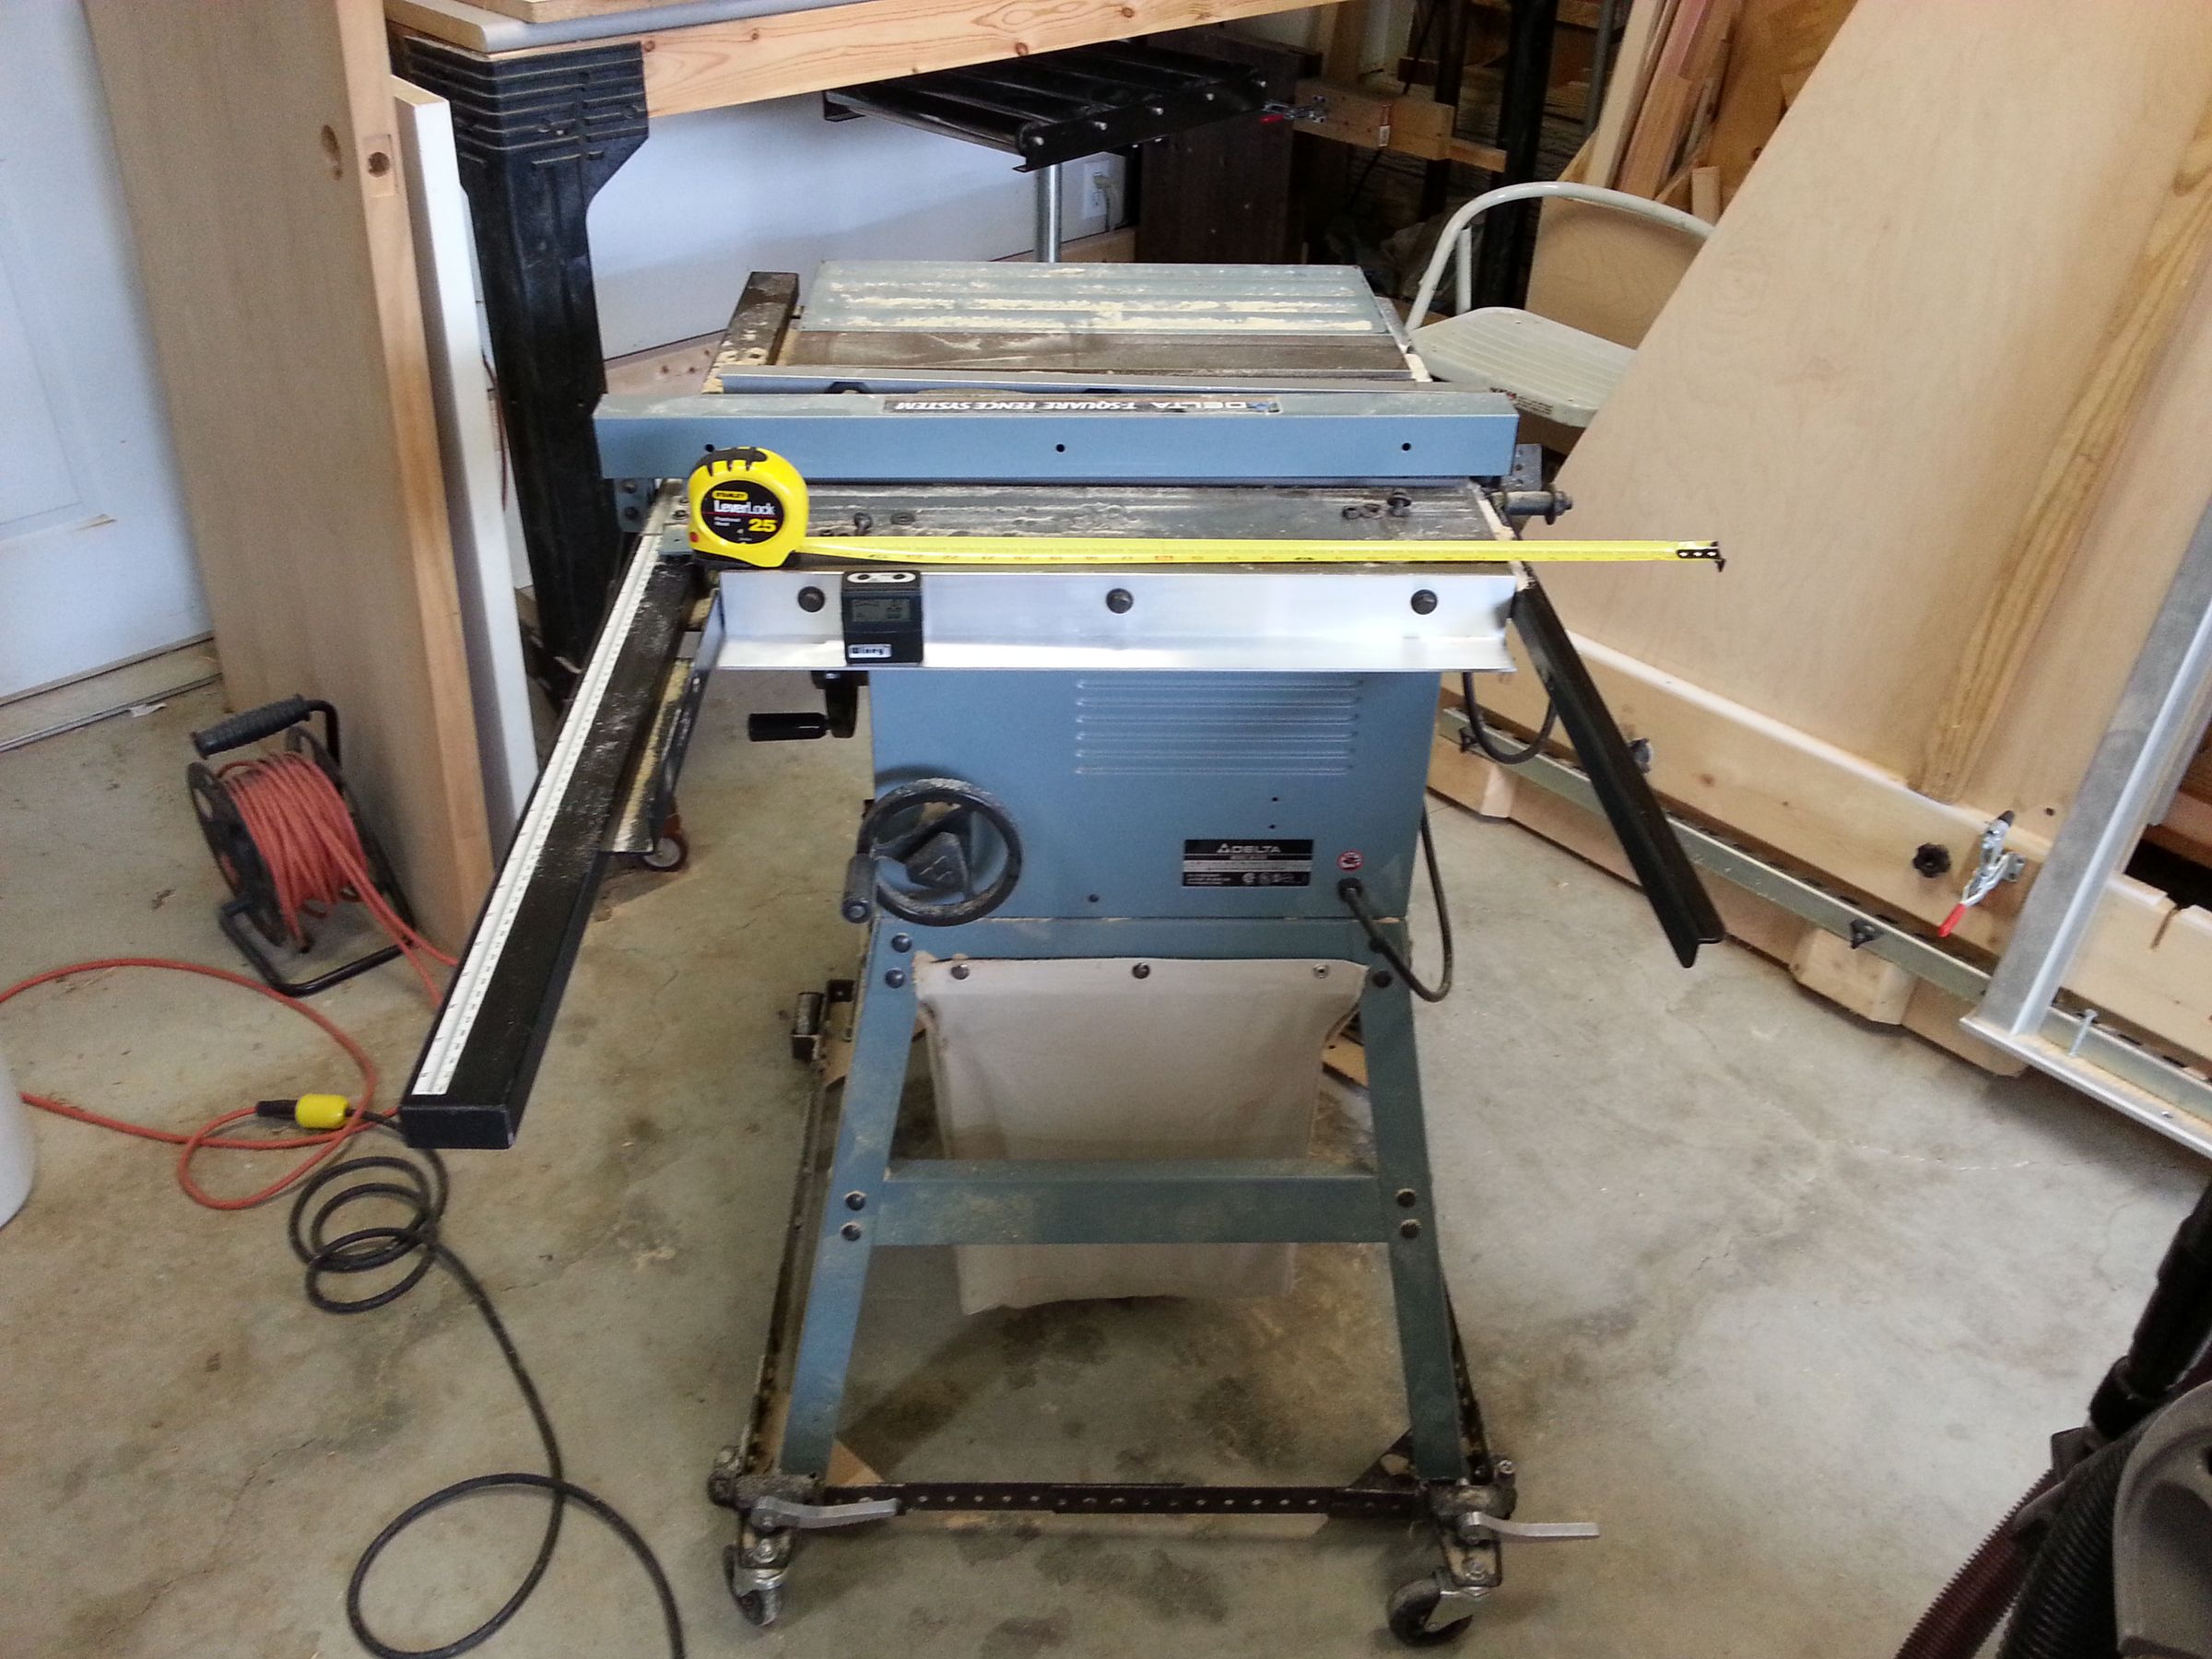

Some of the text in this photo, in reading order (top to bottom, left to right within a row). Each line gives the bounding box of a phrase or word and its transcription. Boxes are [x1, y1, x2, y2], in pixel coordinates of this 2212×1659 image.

[896, 401, 1247, 410] DELTA T-SQUARE FENCE SYSTEM
[713, 500, 775, 515] LeverLock
[748, 518, 777, 533] 25
[1230, 845, 1282, 853] DELTA
